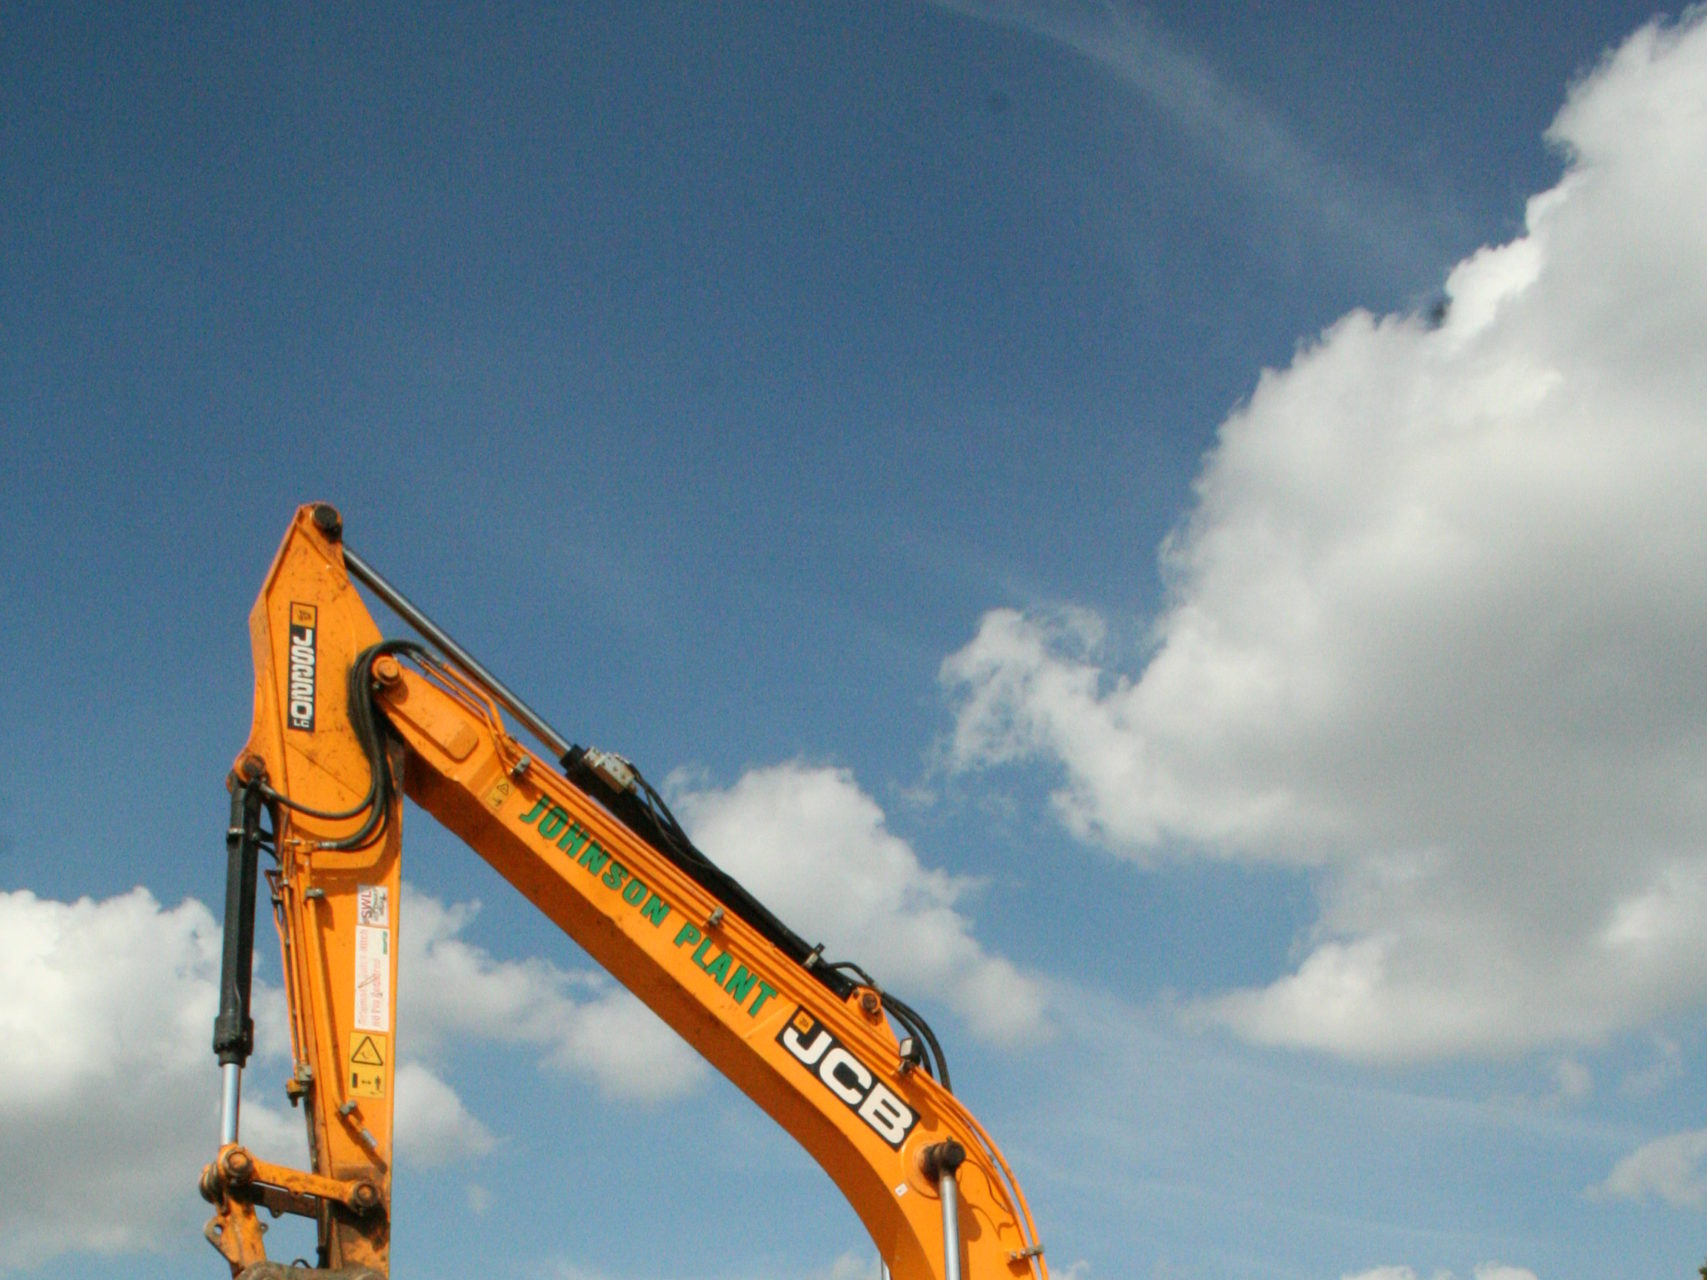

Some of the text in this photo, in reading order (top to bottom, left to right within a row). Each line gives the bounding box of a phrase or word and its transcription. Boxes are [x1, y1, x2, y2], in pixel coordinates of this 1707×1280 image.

[519, 793, 777, 1017] JOHNSON PLANT
[783, 1026, 913, 1144] JCB
